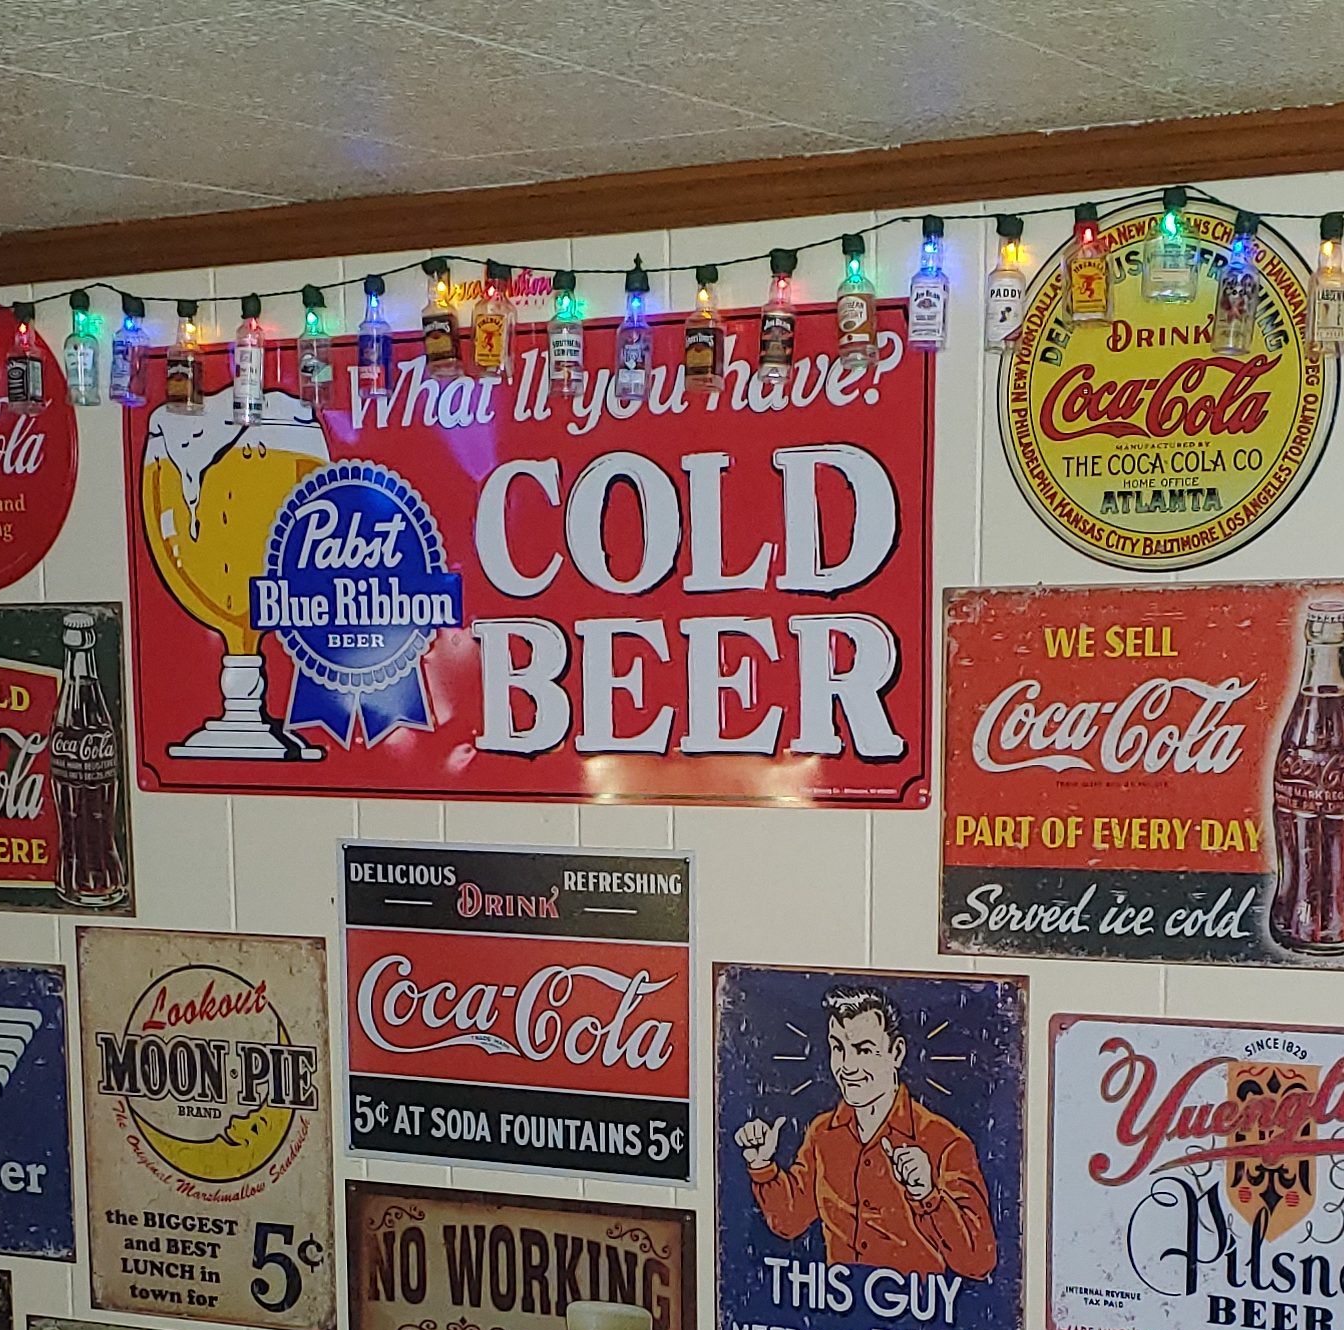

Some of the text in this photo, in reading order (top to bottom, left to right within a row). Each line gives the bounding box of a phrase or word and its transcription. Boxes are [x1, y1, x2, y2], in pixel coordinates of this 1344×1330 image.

[990, 288, 1023, 299] PADDY
[1107, 314, 1215, 352] DRINK
[1039, 353, 1282, 442] Coca-Cola
[1062, 455, 1102, 479] THE
[1122, 477, 1199, 489] HOME OFFICE
[476, 443, 900, 600] COLD
[1100, 487, 1224, 515] ATLANTA
[296, 498, 406, 570] Pabst
[334, 577, 459, 627] Ribbon
[1044, 627, 1178, 658] WE SELL
[474, 614, 905, 760] BEER
[972, 676, 1258, 775] Coca-Cola
[957, 815, 1264, 853] PART OF EVERY DAY
[350, 862, 682, 895] DELICIOUS REFRESHING
[952, 884, 1256, 938] Served ice cold
[143, 980, 269, 1032] Lookout
[357, 954, 678, 1070] Coca-Cola
[1244, 1039, 1308, 1061] SINCE 1829
[431, 1108, 642, 1155] SODA FOUNTAINS
[105, 1209, 238, 1236] the BIGGEST
[120, 1258, 195, 1280] LUNCH
[124, 1237, 222, 1260] and BEST
[368, 1226, 427, 1304] NO
[763, 1257, 962, 1324] THIS GUY
